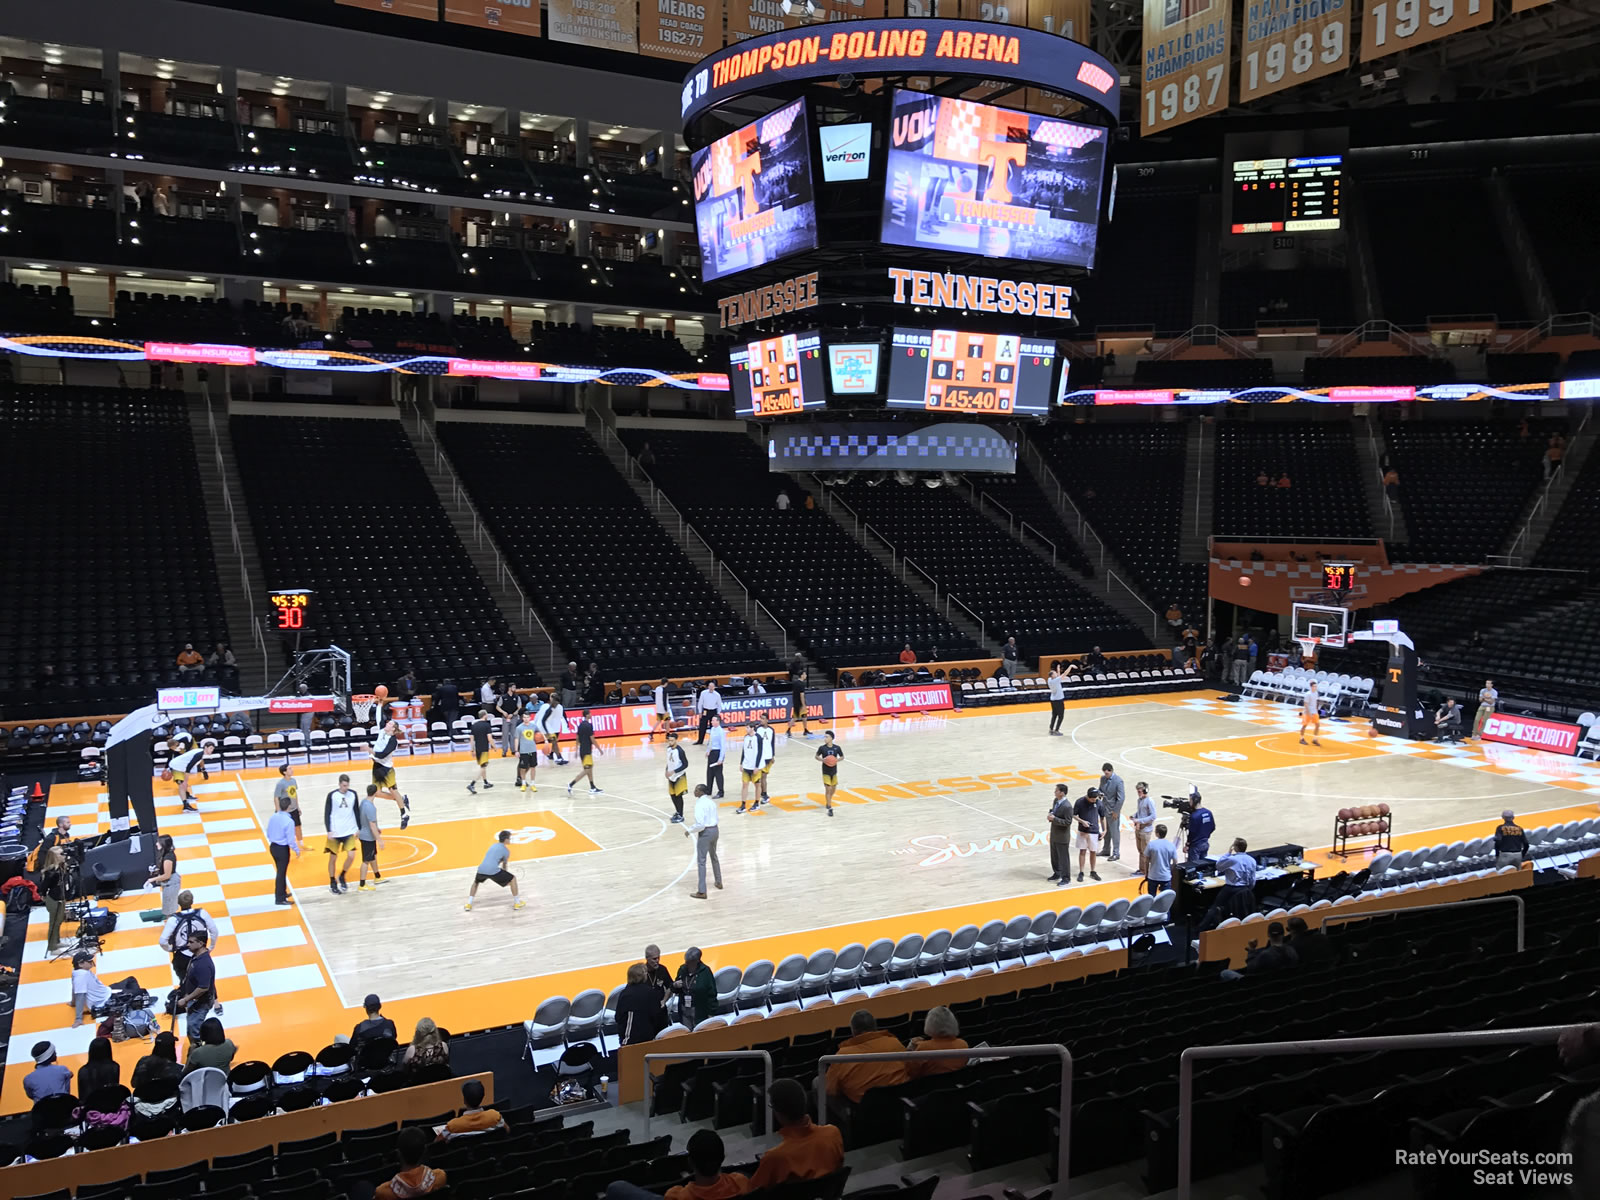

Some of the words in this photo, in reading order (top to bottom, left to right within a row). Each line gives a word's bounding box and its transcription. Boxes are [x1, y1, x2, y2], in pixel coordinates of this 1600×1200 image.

[658, 0, 705, 20] MEARS
[659, 18, 678, 28] HEAD
[680, 21, 704, 33] COACH
[1248, 0, 1346, 42] CHAMPIONS
[553, 22, 633, 44] CHAMPIONSHIPS
[658, 29, 704, 48] 1962-77
[1147, 19, 1225, 64] NATIONAL
[695, 68, 709, 99] TO
[712, 29, 928, 88] THOMPSON-BOLING
[935, 30, 1020, 64] ARENA
[1146, 37, 1225, 82] CHAMPIONS
[1247, 21, 1344, 91] 1989
[1146, 64, 1224, 127] 1987
[826, 151, 866, 163] verizon
[1409, 149, 1429, 160] 311
[955, 201, 1037, 225] TENNESSEE
[717, 271, 820, 329] TENNESSEE
[888, 267, 1072, 319] TENNESSEE
[151, 346, 173, 354] Farm
[173, 347, 201, 357] Bureau
[202, 348, 251, 360] INSURANCE
[453, 361, 471, 370] Farm
[472, 362, 495, 372] Bureau
[495, 363, 536, 374] INSURANCE
[937, 363, 947, 377] 0
[956, 371, 964, 380] 4
[982, 372, 990, 382] 4
[1000, 367, 1009, 381] 0
[945, 390, 995, 409] 45:40
[1099, 392, 1114, 401] Farm
[1115, 392, 1134, 400] Bureau
[1135, 391, 1170, 400] INSURANCE
[1333, 389, 1350, 398] Farm
[1351, 389, 1372, 397] Bureau
[1372, 388, 1411, 397] INSURANCE
[1324, 566, 1345, 576] 45:39
[1327, 574, 1342, 589] 30
[271, 594, 307, 607] 45:39
[278, 607, 302, 628] 30
[1388, 668, 1401, 683] T
[162, 696, 185, 704] FOOD
[197, 694, 216, 703] CITY
[720, 698, 772, 713] WELCOME
[774, 697, 789, 709] TO
[844, 692, 866, 714] T
[632, 707, 657, 732] T
[1376, 717, 1404, 729] verizon
[338, 797, 349, 809] A
